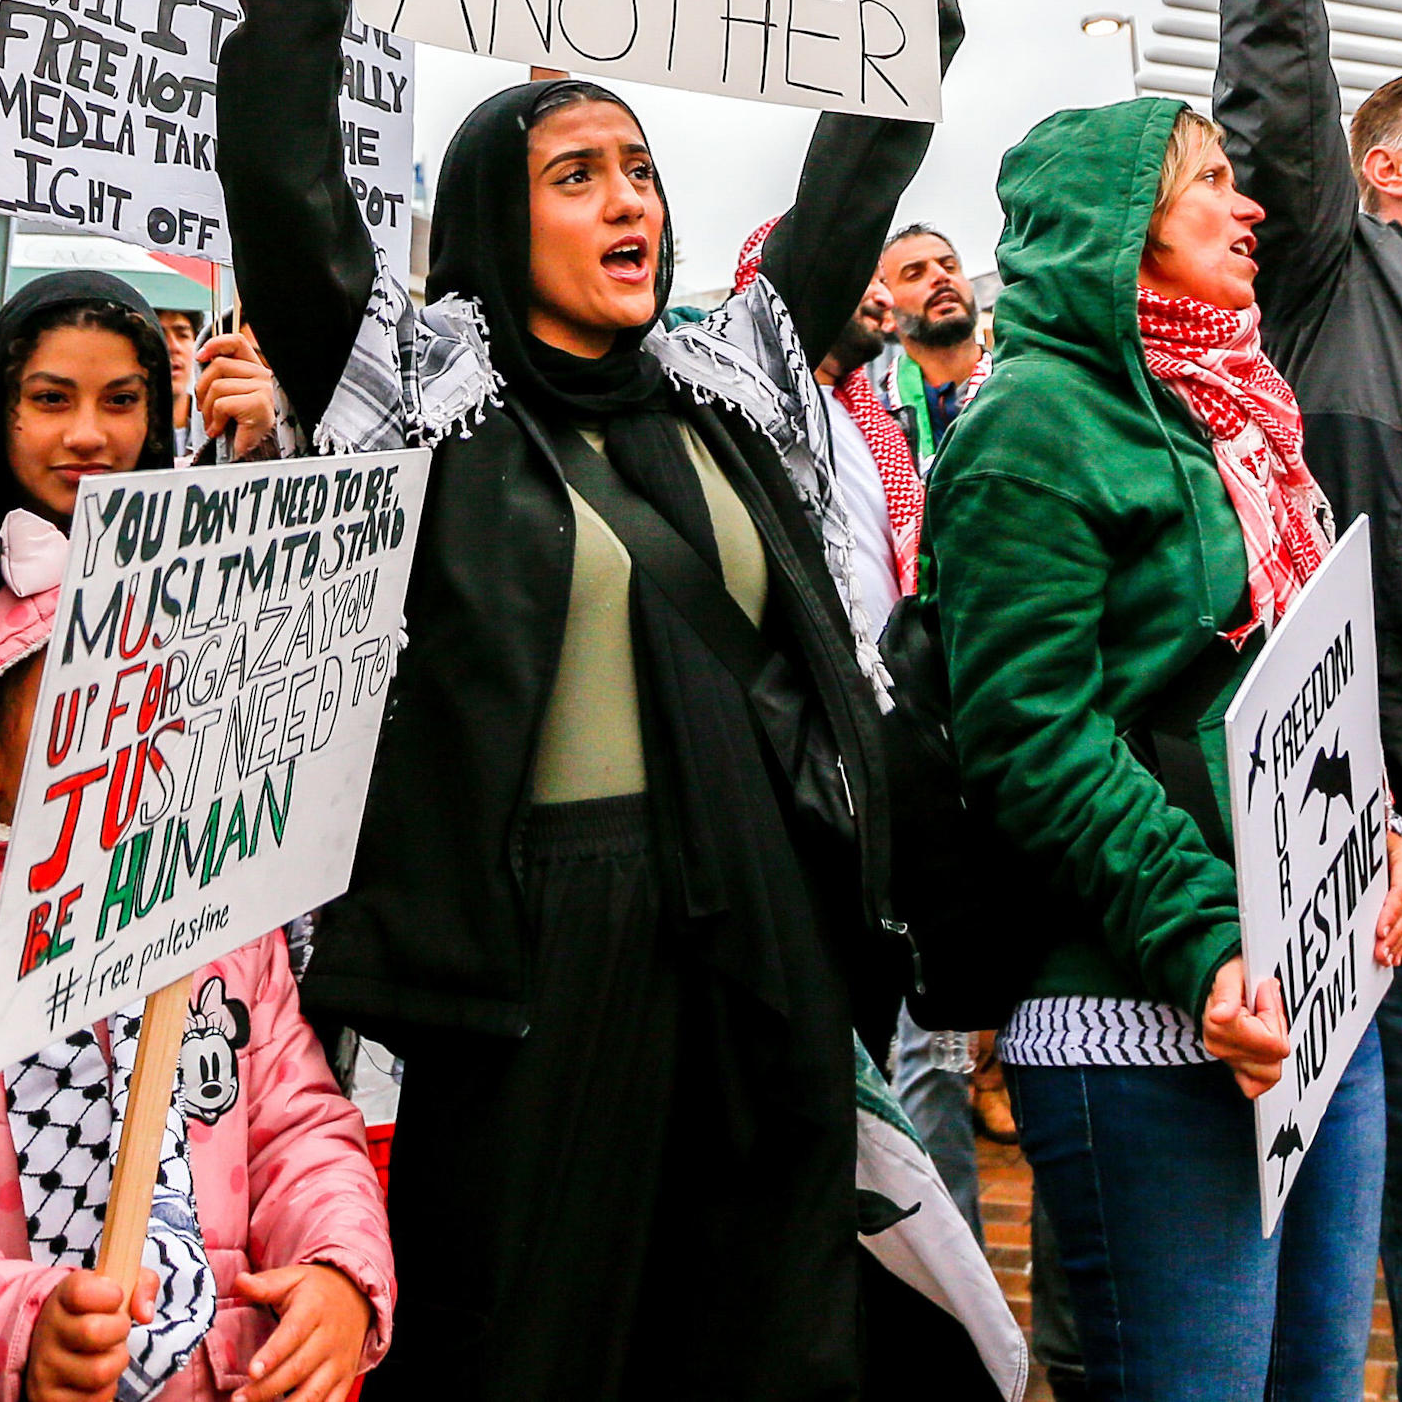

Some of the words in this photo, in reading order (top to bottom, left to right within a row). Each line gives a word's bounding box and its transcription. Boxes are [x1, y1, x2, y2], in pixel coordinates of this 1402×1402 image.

[127, 53, 218, 119] NOT
[144, 114, 218, 172] TAK
[147, 206, 221, 250] OFF
[60, 538, 278, 668] MUSLIM
[279, 530, 321, 602] TO
[319, 505, 406, 581] STAND
[83, 487, 172, 578] YOU
[178, 476, 269, 550] DON'T
[267, 474, 328, 530] NEED
[332, 467, 363, 518] TO
[48, 682, 99, 767] UP
[101, 649, 189, 752] FOR
[187, 589, 315, 707] GAZA
[318, 566, 380, 655] YOU
[1272, 620, 1354, 795] FREEDOM
[28, 708, 224, 893] JUST
[214, 656, 343, 794] NEED
[351, 634, 392, 707] TO
[17, 882, 84, 983] BE
[95, 758, 296, 942] HUMAN
[136, 902, 230, 990] palestine
